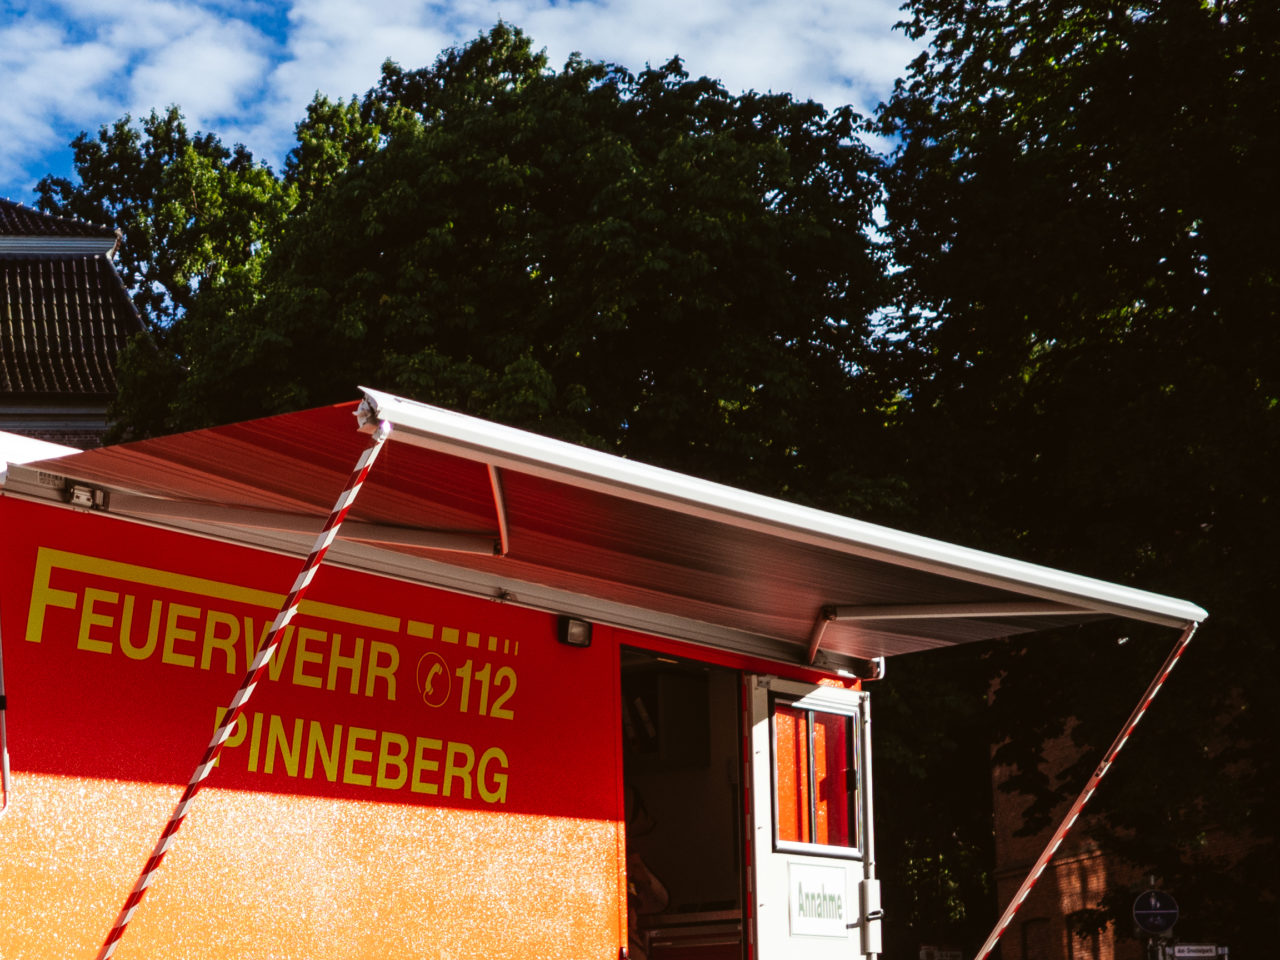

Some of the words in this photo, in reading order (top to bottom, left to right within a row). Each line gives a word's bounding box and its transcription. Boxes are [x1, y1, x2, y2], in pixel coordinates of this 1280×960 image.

[24, 546, 401, 701] FEUERWEHR
[455, 659, 518, 721] 112
[213, 706, 510, 804] PINNEBERG
[798, 881, 843, 920] Annahme
